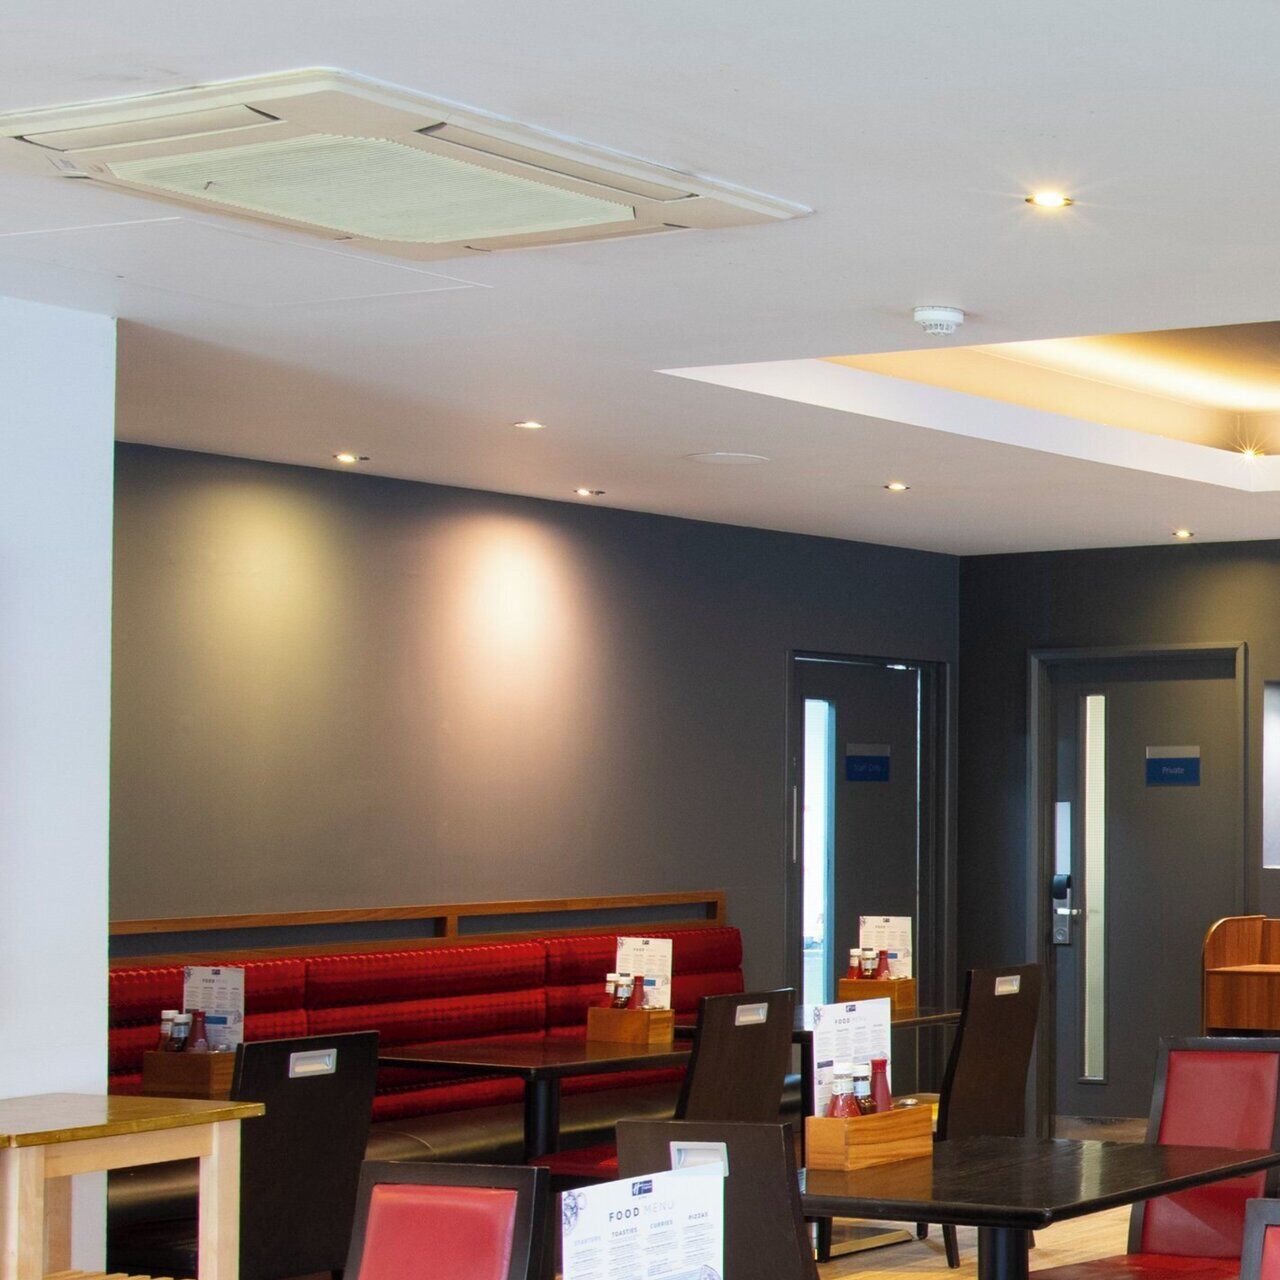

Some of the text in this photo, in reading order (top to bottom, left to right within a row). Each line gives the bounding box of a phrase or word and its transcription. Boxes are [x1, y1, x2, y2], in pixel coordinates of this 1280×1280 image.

[1162, 766, 1185, 776] Private
[609, 1200, 674, 1222] FOOD MENU
[688, 1211, 709, 1221] PIZZAS
[650, 1219, 674, 1230] CURRIES
[612, 1227, 638, 1238] TOASTIES
